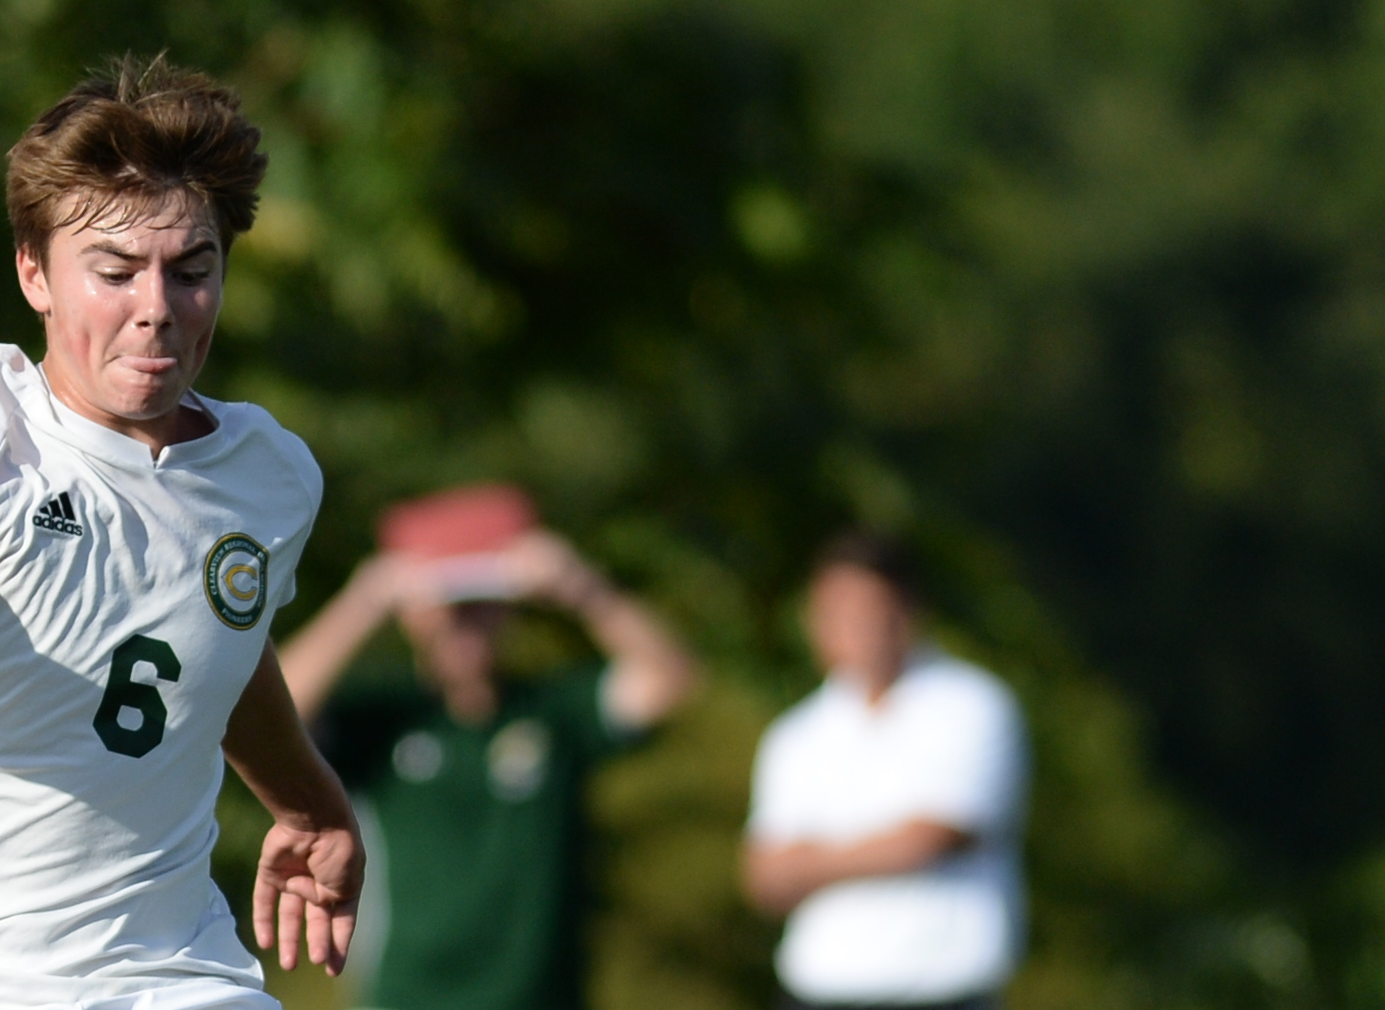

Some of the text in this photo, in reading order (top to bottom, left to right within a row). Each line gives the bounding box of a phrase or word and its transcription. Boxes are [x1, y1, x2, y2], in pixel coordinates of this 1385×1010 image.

[32, 515, 83, 537] adidas
[220, 564, 258, 602] C
[92, 633, 182, 759] 6
